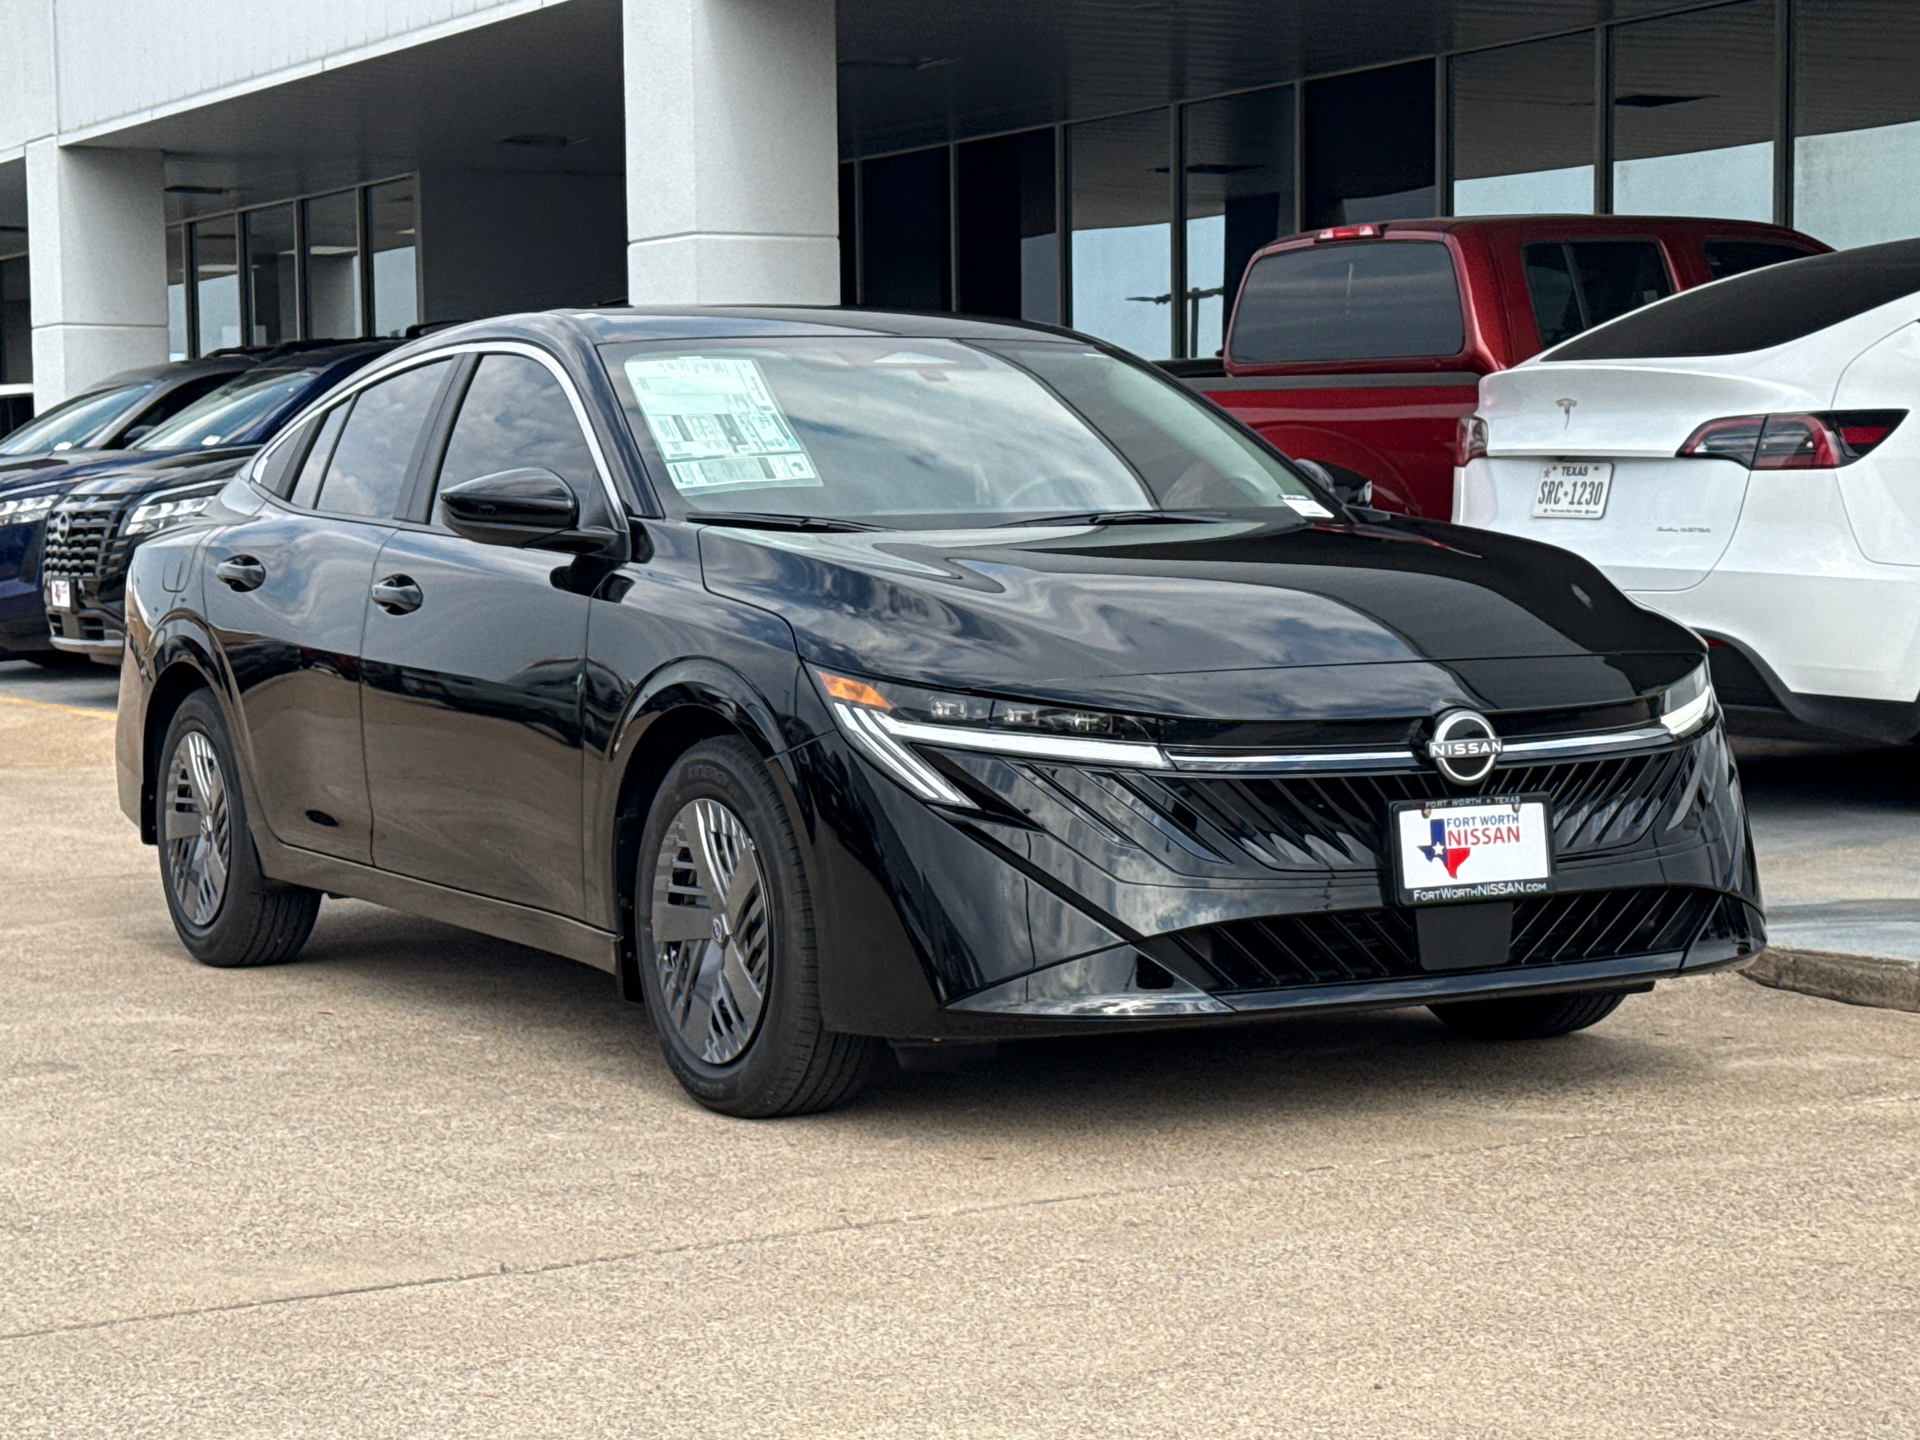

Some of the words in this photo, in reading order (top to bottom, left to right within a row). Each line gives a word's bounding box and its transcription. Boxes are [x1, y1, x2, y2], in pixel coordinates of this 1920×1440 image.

[1561, 465, 1589, 477] TEXAS
[1431, 741, 1501, 756] NISSAN
[1425, 799, 1448, 809] FORT
[1451, 797, 1482, 807] WORTH
[1494, 795, 1521, 804] TEXAS
[1446, 815, 1477, 828] FORT
[1479, 813, 1520, 826] WORTH
[1447, 825, 1521, 847] NISSAN
